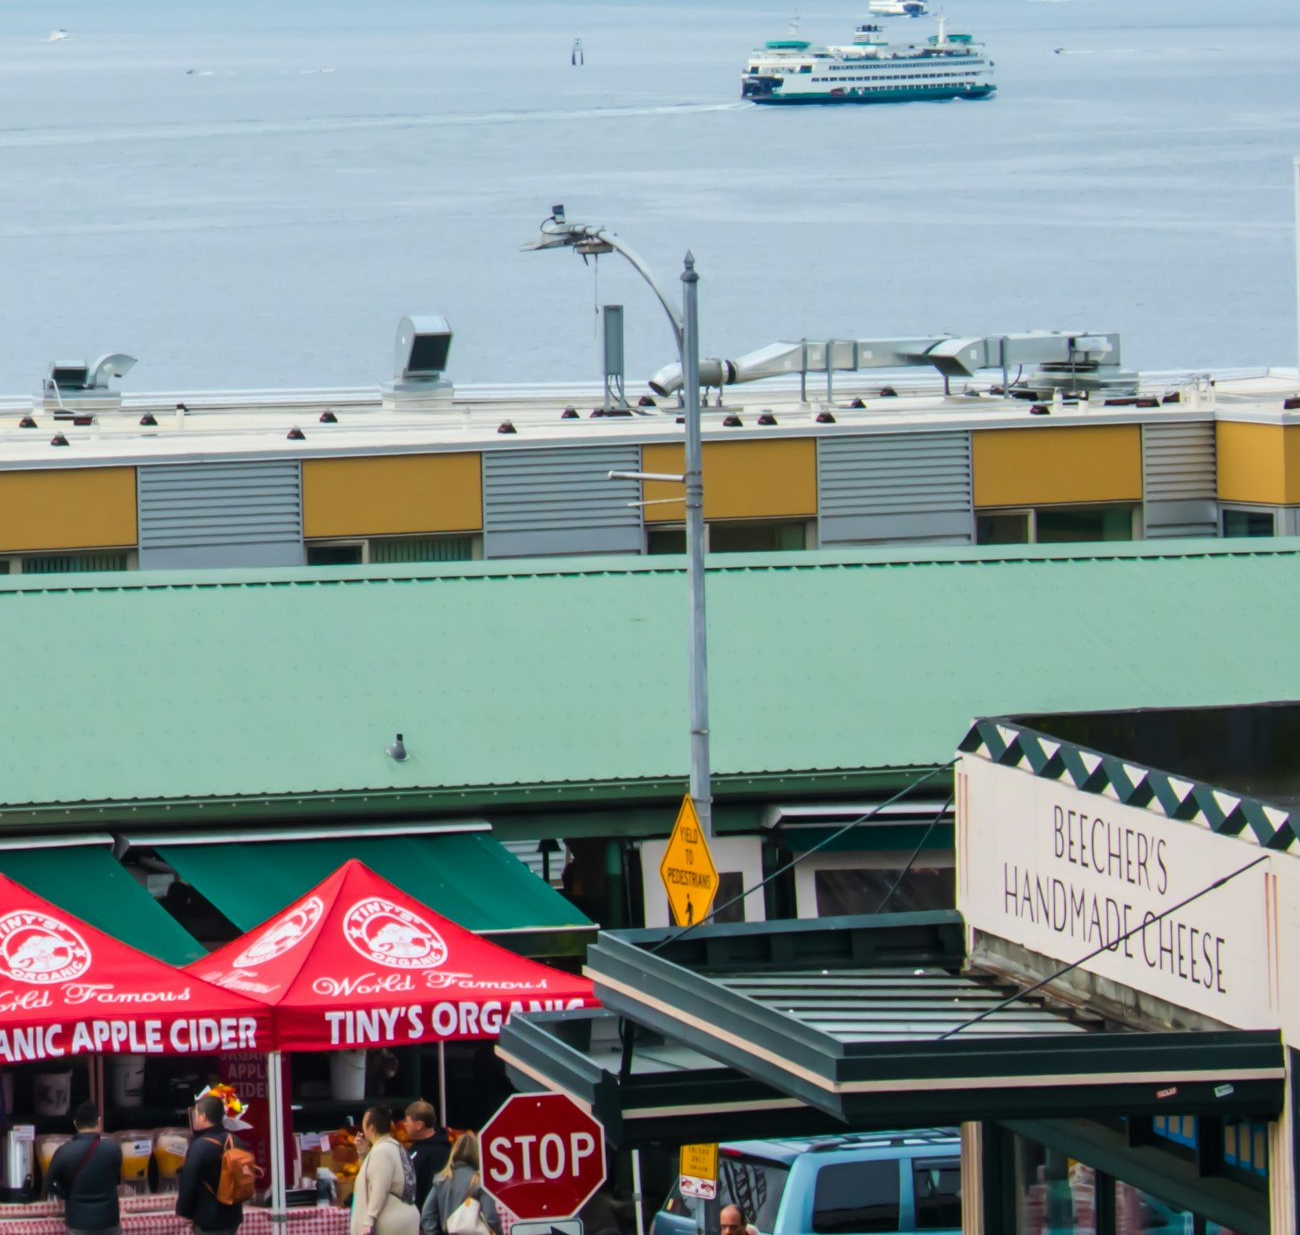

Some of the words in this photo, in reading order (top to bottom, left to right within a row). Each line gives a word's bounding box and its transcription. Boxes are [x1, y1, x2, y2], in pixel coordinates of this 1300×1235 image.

[680, 826, 699, 845] YIELD
[685, 848, 694, 866] TO
[1053, 804, 1168, 896] BEECHER'S
[667, 867, 712, 890] PEDESTRIANS
[351, 901, 414, 923] TINY'S
[1003, 862, 1134, 959] HANDMADE
[1141, 910, 1227, 995] CHEESE
[10, 959, 83, 982] ORGANIC
[61, 983, 191, 1005] Famous
[312, 971, 416, 997] World
[422, 970, 548, 990] Famous
[324, 1004, 424, 1045] TINY'S
[71, 1018, 164, 1056] APPLE
[170, 1017, 257, 1053] CIDER
[228, 1063, 269, 1081] APPL
[489, 1132, 595, 1183] STOP
